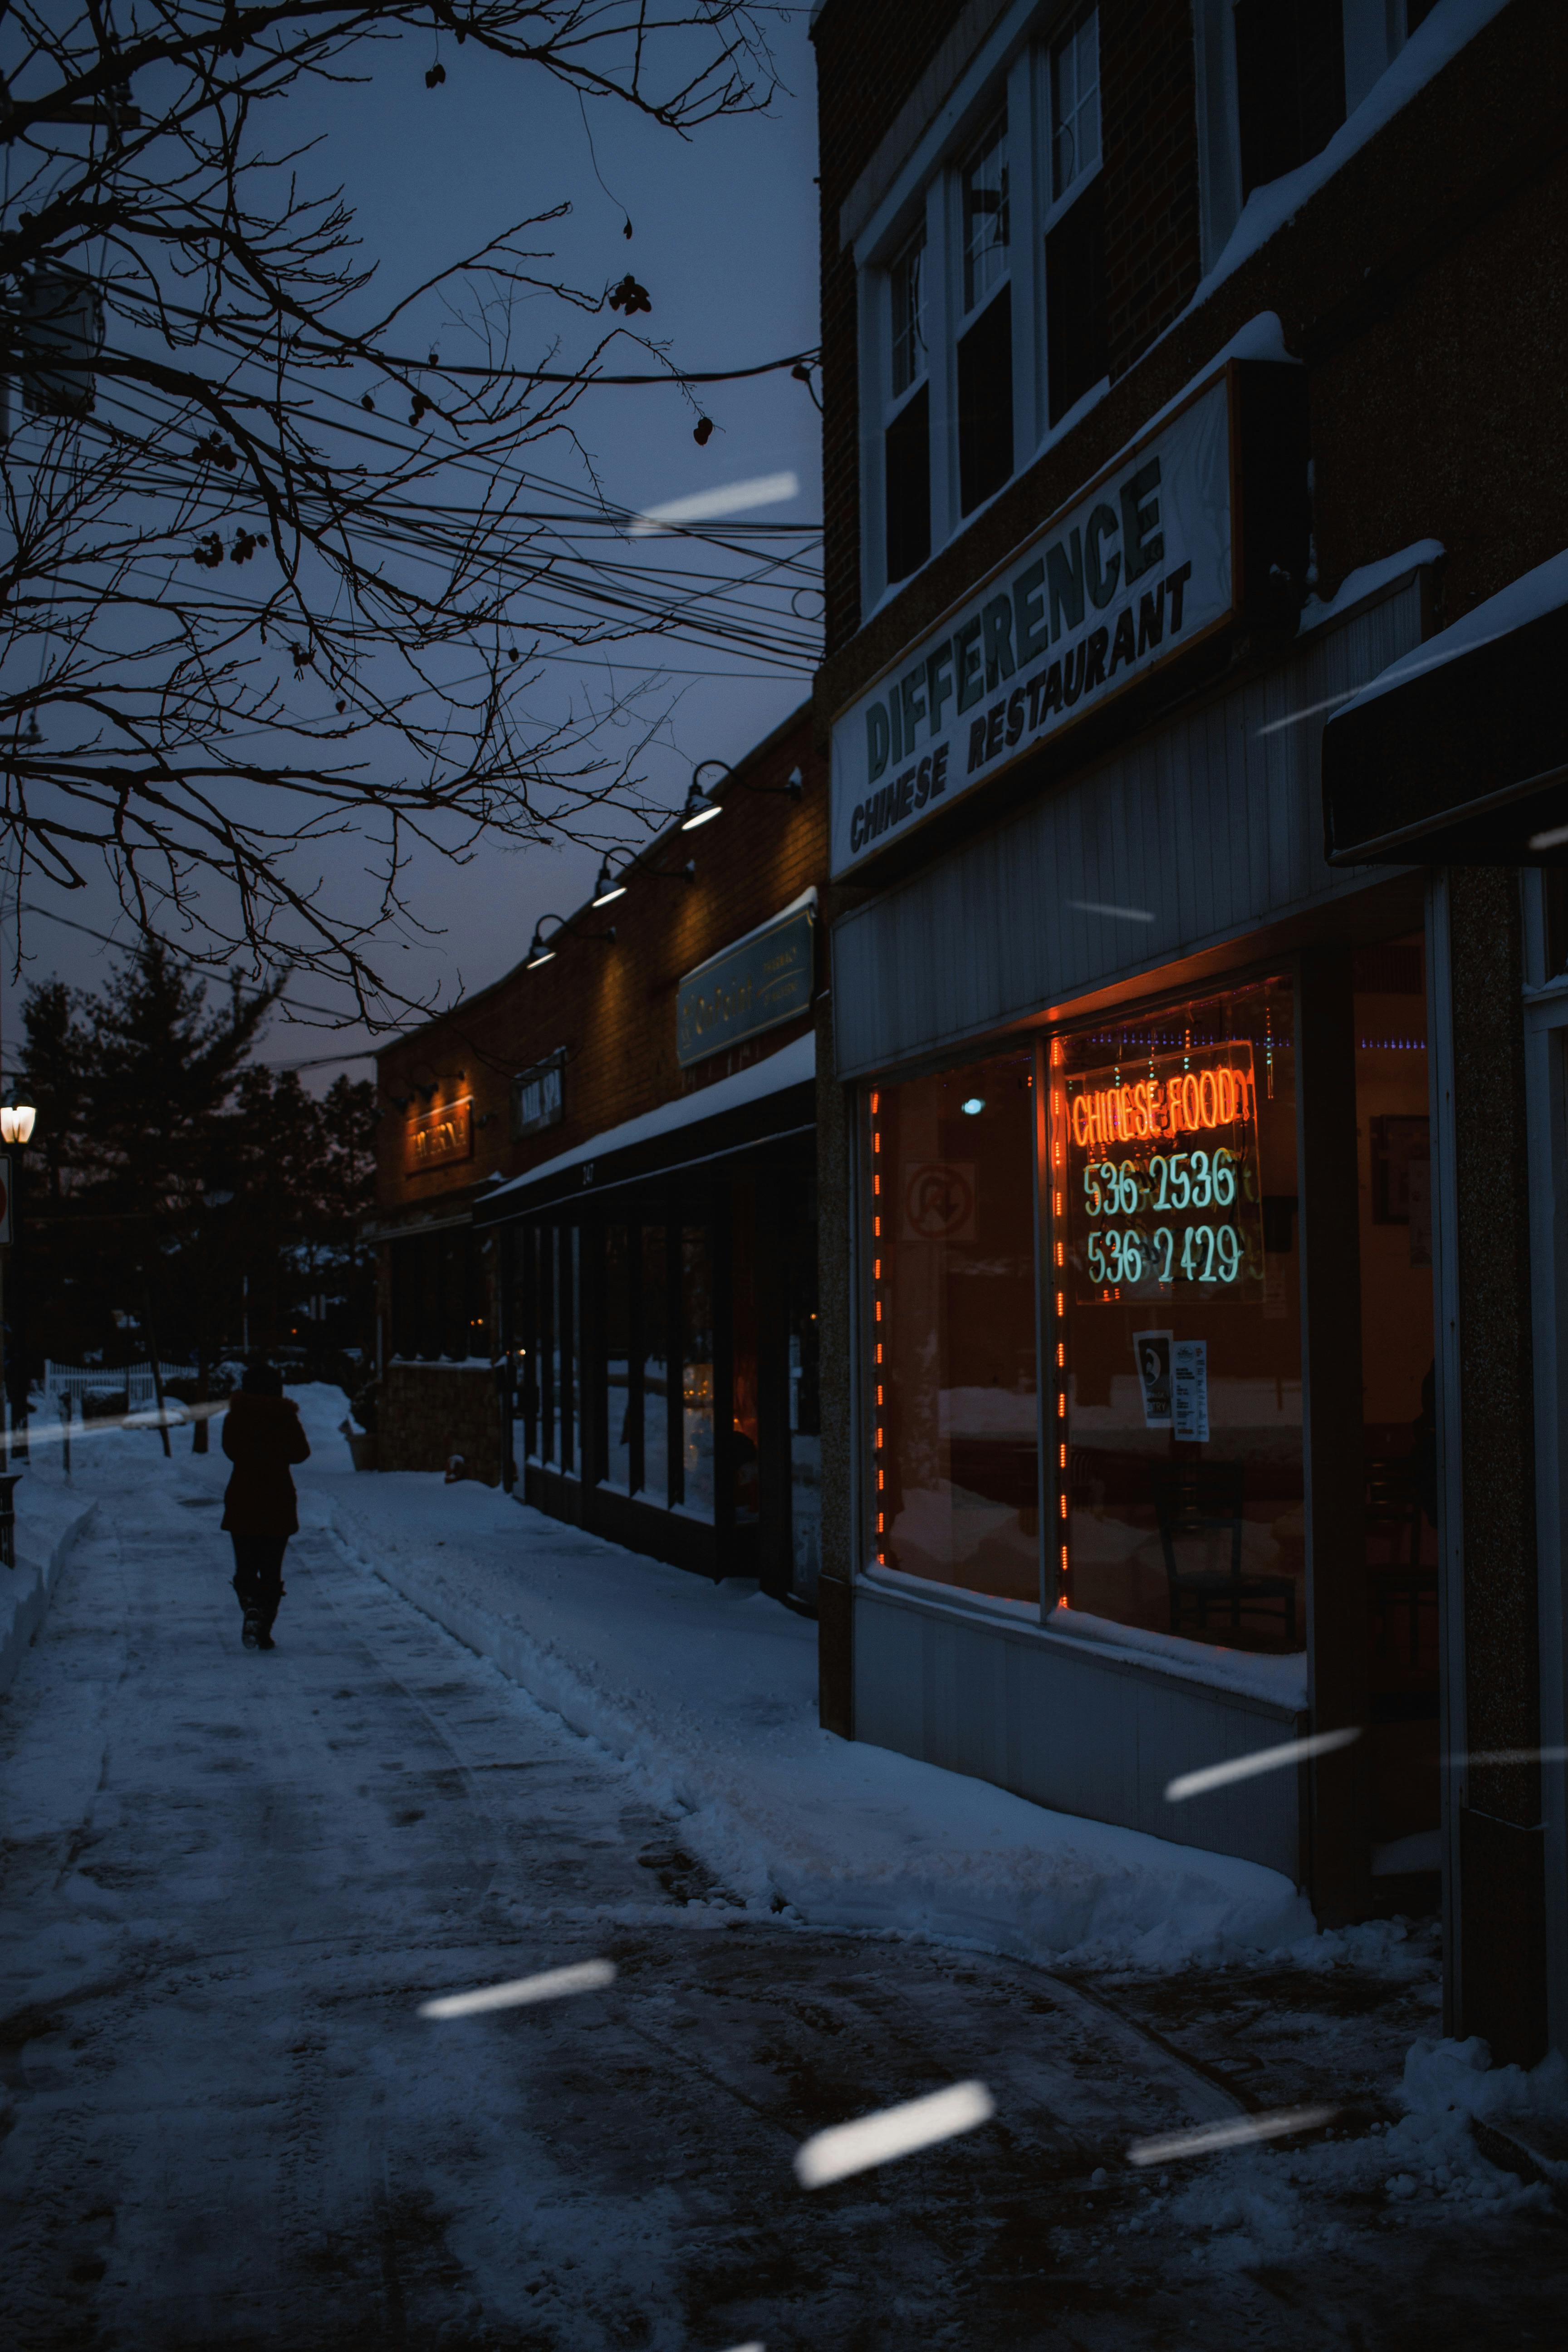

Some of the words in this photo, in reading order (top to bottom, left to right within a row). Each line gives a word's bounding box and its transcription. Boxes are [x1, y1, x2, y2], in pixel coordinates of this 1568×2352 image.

[849, 741, 949, 853] CHINESE
[967, 561, 1191, 774] RESTAURANT
[865, 456, 1164, 784] DIFFERENCE
[1073, 1081, 1160, 1146] CHINESE
[1169, 1068, 1235, 1132] FOOD
